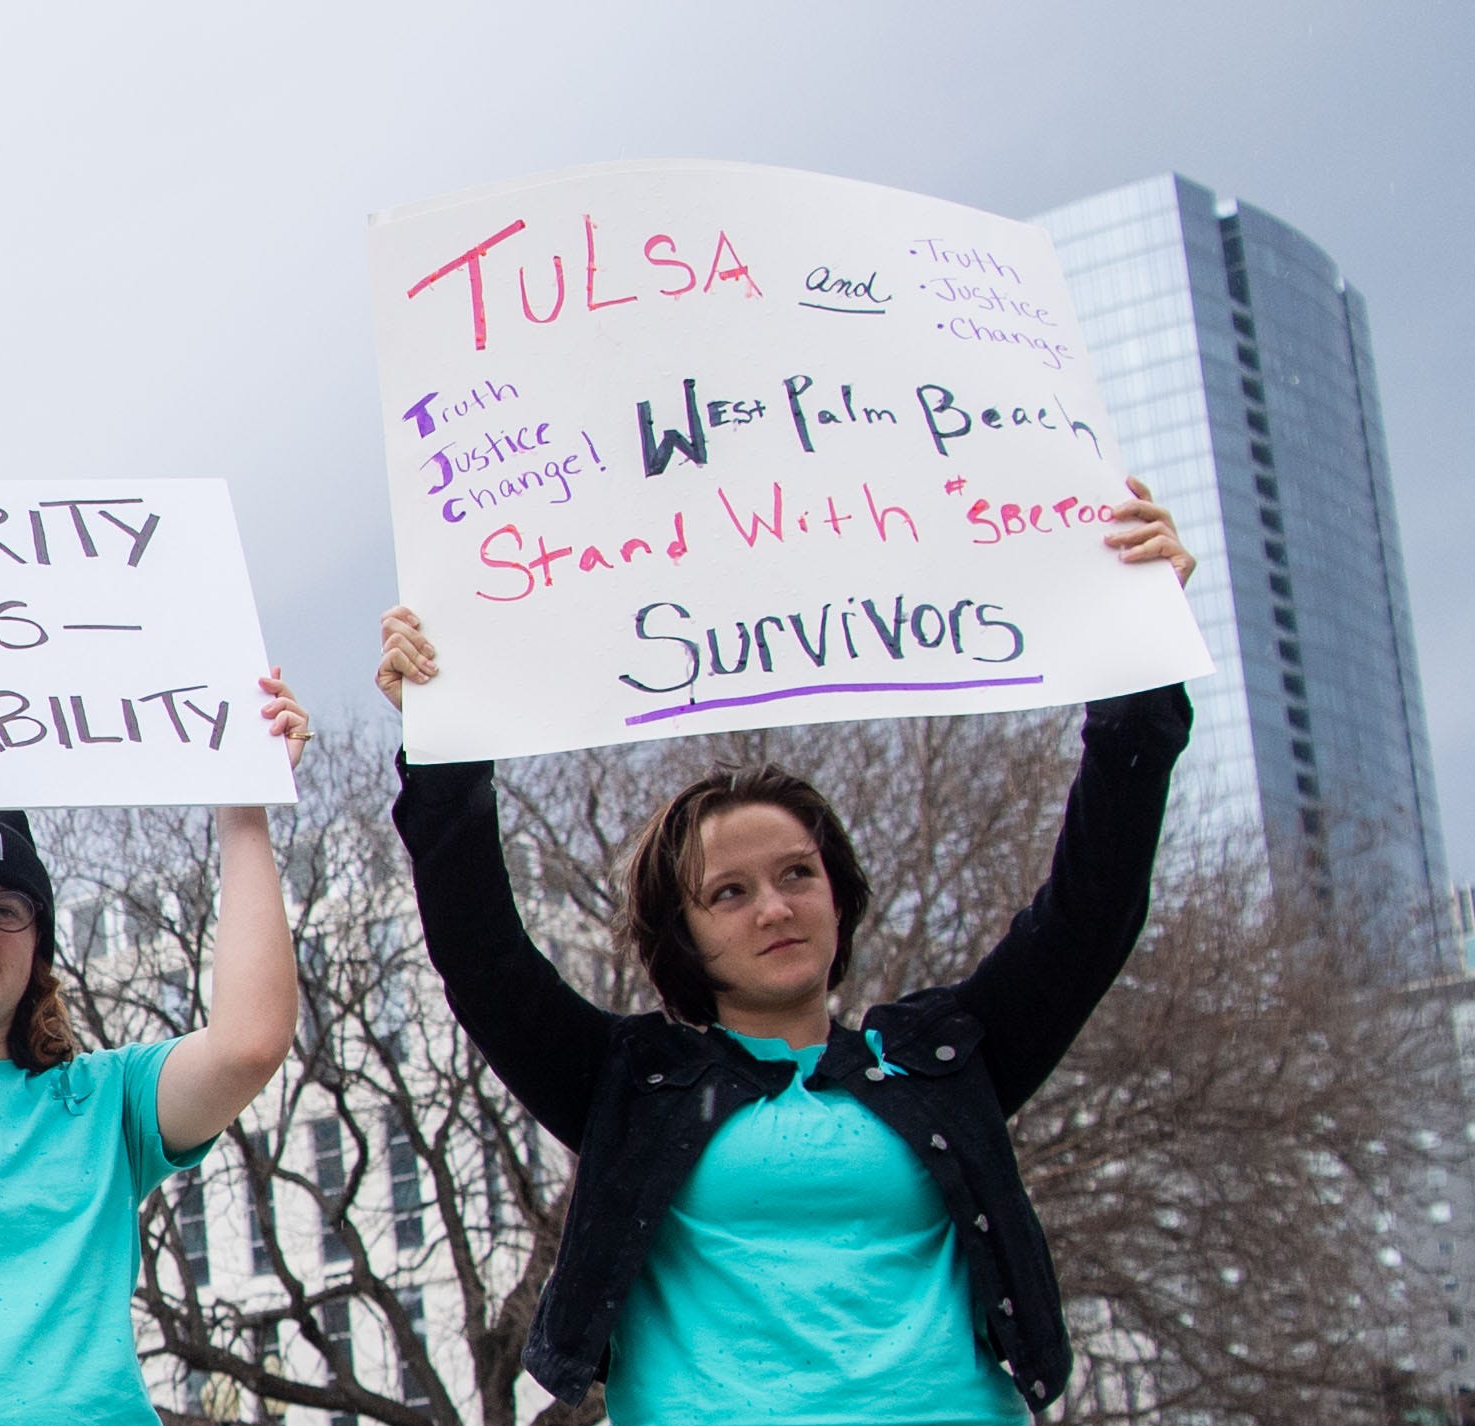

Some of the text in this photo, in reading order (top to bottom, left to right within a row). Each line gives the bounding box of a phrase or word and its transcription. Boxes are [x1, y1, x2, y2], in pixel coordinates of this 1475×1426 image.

[406, 214, 892, 350] TULSA and
[402, 381, 519, 438] Truth
[784, 375, 897, 453] Palm
[916, 384, 1103, 459] Beach
[420, 423, 550, 495] Justice
[476, 512, 687, 601] Stand
[718, 481, 919, 547] With
[618, 595, 1024, 692] Survivors
